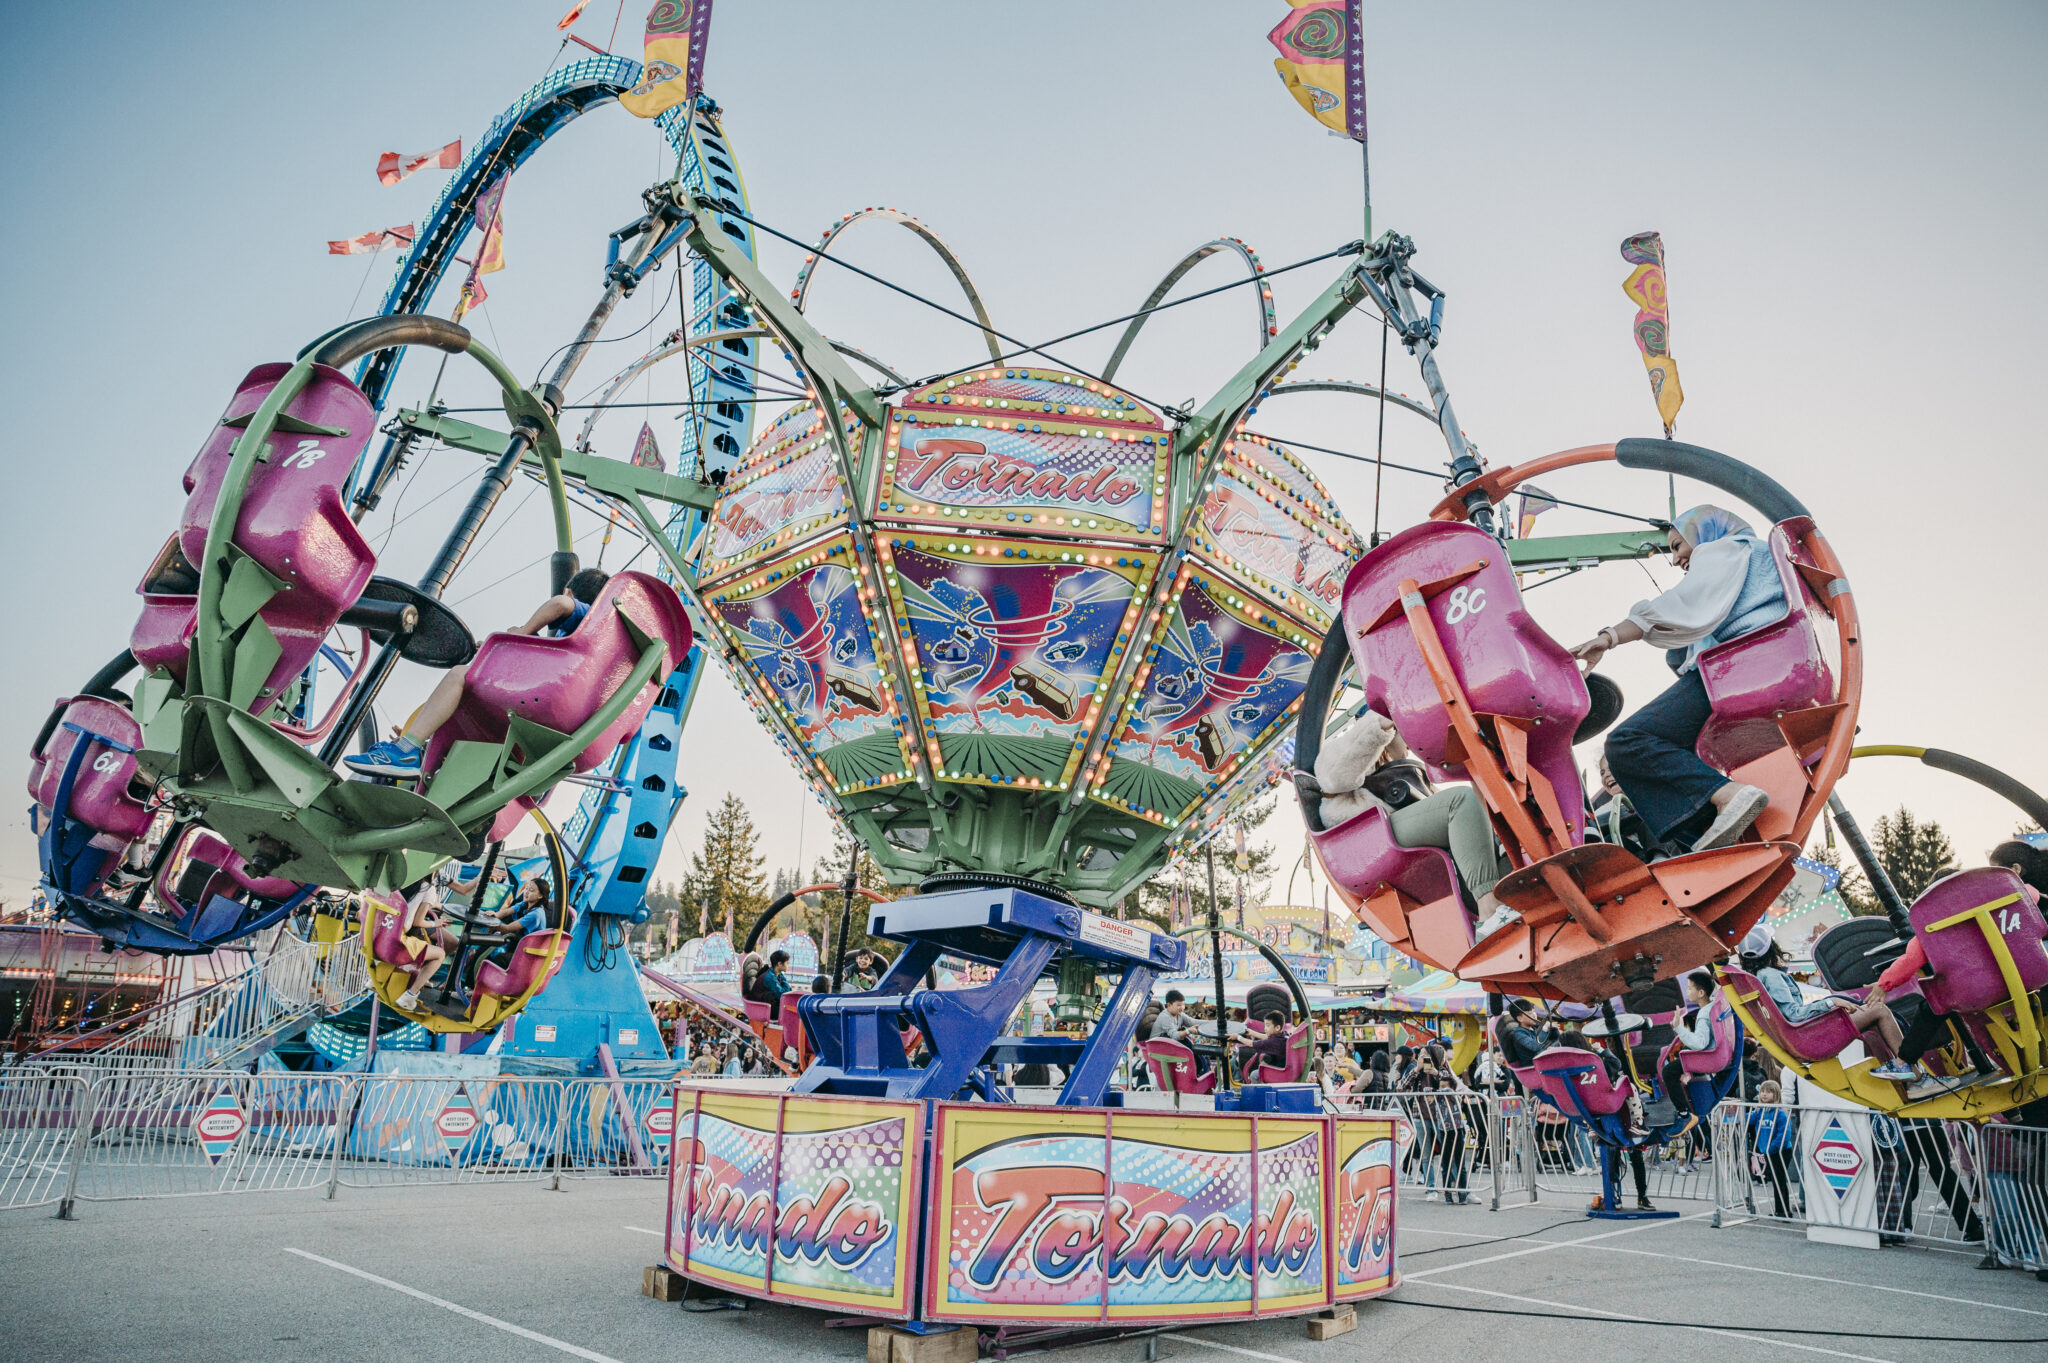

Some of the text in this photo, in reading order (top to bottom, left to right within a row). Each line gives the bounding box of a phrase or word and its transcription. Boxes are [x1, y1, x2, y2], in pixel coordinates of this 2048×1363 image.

[281, 439, 327, 469] 7B
[907, 438, 1143, 505] Tornado
[713, 464, 839, 556] Tornado
[1211, 484, 1342, 606] Tornado
[1445, 585, 1487, 626] 8C
[92, 751, 121, 774] 6A
[381, 913, 395, 930] 5C
[1100, 920, 1134, 937] DANGER
[1998, 908, 2021, 935] 1A
[1174, 1061, 1189, 1075] 3A
[1580, 1071, 1598, 1086] 2A
[966, 1162, 1320, 1292] Tornado
